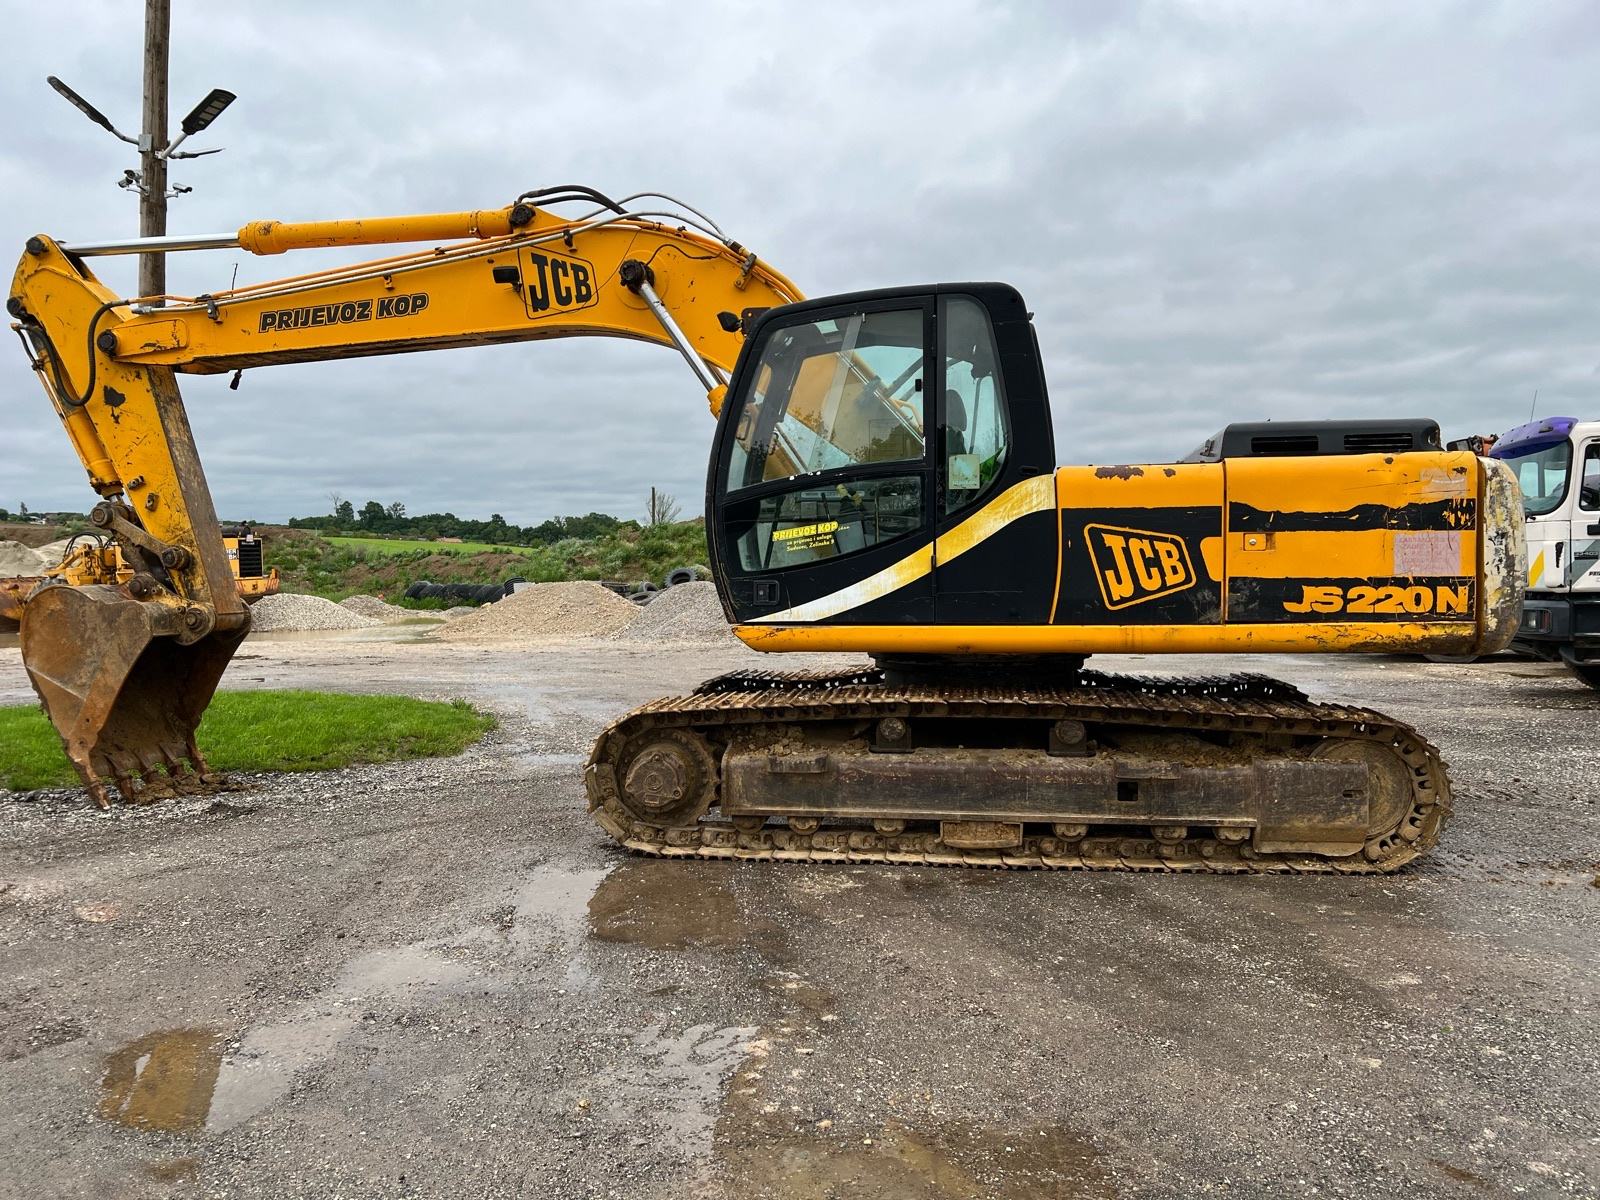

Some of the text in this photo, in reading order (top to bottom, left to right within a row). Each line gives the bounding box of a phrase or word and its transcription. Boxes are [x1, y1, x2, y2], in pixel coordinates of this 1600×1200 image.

[528, 251, 593, 313] JCB
[259, 292, 429, 333] PRIJEVOZ KOP
[772, 525, 816, 541] PRIJEVOZ
[818, 521, 838, 533] KOP
[1100, 532, 1186, 601] JCB
[1282, 584, 1471, 615] JS220N
